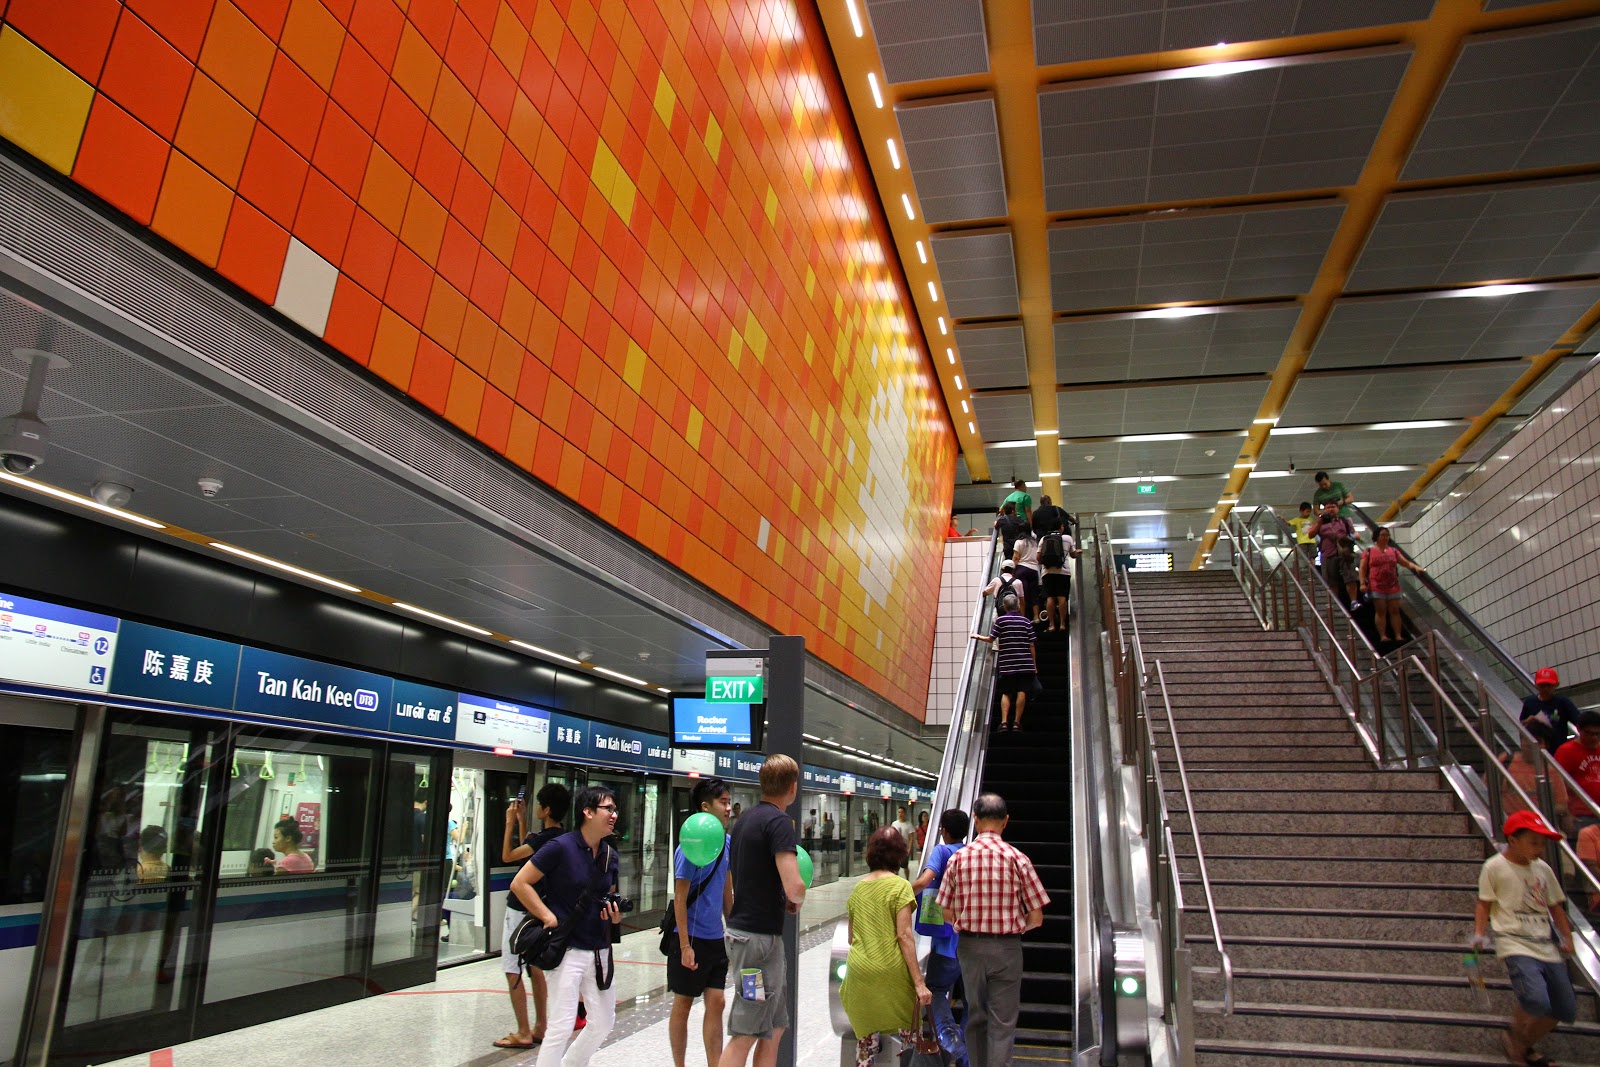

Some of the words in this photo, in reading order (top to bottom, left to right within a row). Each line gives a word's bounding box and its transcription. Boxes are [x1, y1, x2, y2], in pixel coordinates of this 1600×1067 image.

[96, 640, 108, 652] 12
[142, 649, 214, 685] 陈嘉庚
[257, 671, 288, 697] Tan
[291, 678, 322, 703] Kah
[325, 685, 353, 708] Kee
[359, 694, 375, 706] DT8
[712, 680, 746, 699] EXIT
[697, 715, 728, 724] Rochor
[697, 725, 727, 734] Arrived
[595, 734, 607, 749] Tan
[608, 737, 620, 751] Kah
[620, 739, 632, 753] Kee
[301, 814, 315, 822] Care
